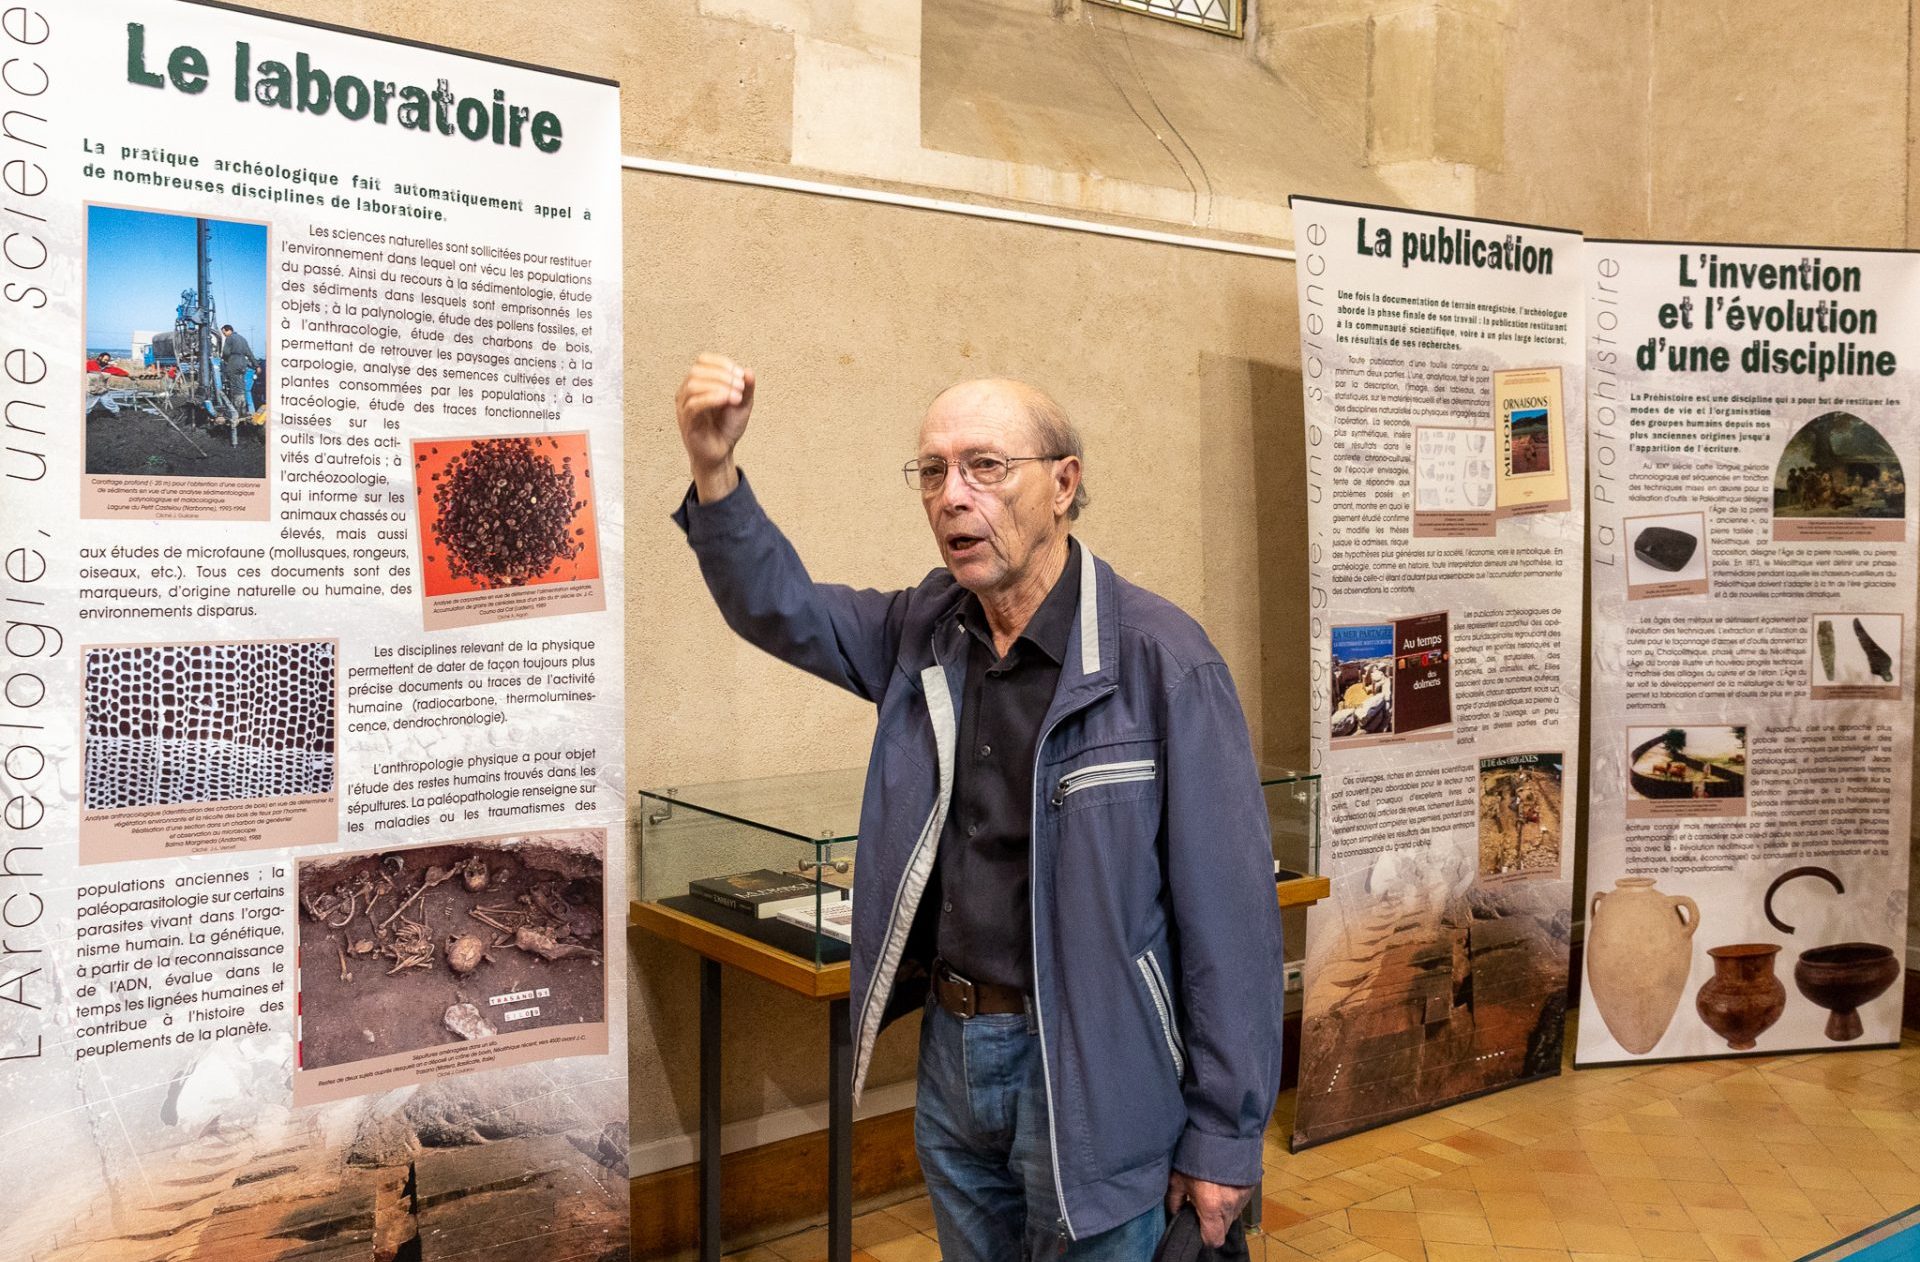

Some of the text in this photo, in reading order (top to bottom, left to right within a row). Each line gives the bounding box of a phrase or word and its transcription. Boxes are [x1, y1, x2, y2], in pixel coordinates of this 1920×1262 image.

[126, 22, 563, 154] Le laboratoire
[2, 7, 50, 309] science
[83, 137, 592, 221] La pratique archéologique fait automatiquement appel à
[82, 163, 447, 222] de nombreuses disciplines de laboratoire.
[281, 239, 593, 286] l'environnement dans lequel ont vécu les populations
[309, 223, 592, 268] Les sciences naturelles sont sollicitées pour restituer
[1357, 217, 1553, 275] La publication
[1679, 253, 1861, 292] L'invention
[1304, 223, 1327, 401] science
[1658, 296, 1877, 334] et l'évolution
[1336, 333, 1462, 351] les résultats de ses recherches.
[1636, 337, 1897, 382] d'une discipline
[1503, 396, 1548, 410] ORNAISONS
[1592, 257, 1620, 566] La Protohistoire
[1629, 405, 1772, 417] modes de vie et l'organisation
[1629, 417, 1771, 430] des groupes humains depuis nos
[1309, 424, 1322, 504] une
[79, 564, 411, 581] oiseaux, etc.). Tous ces documents sont des
[374, 638, 596, 658] Les disciplines relevant de la physique
[1403, 638, 1415, 650] Au
[1417, 634, 1442, 647] temps
[1413, 679, 1441, 690] dolmens
[76, 961, 285, 999] de l'ADN, évalue dans le
